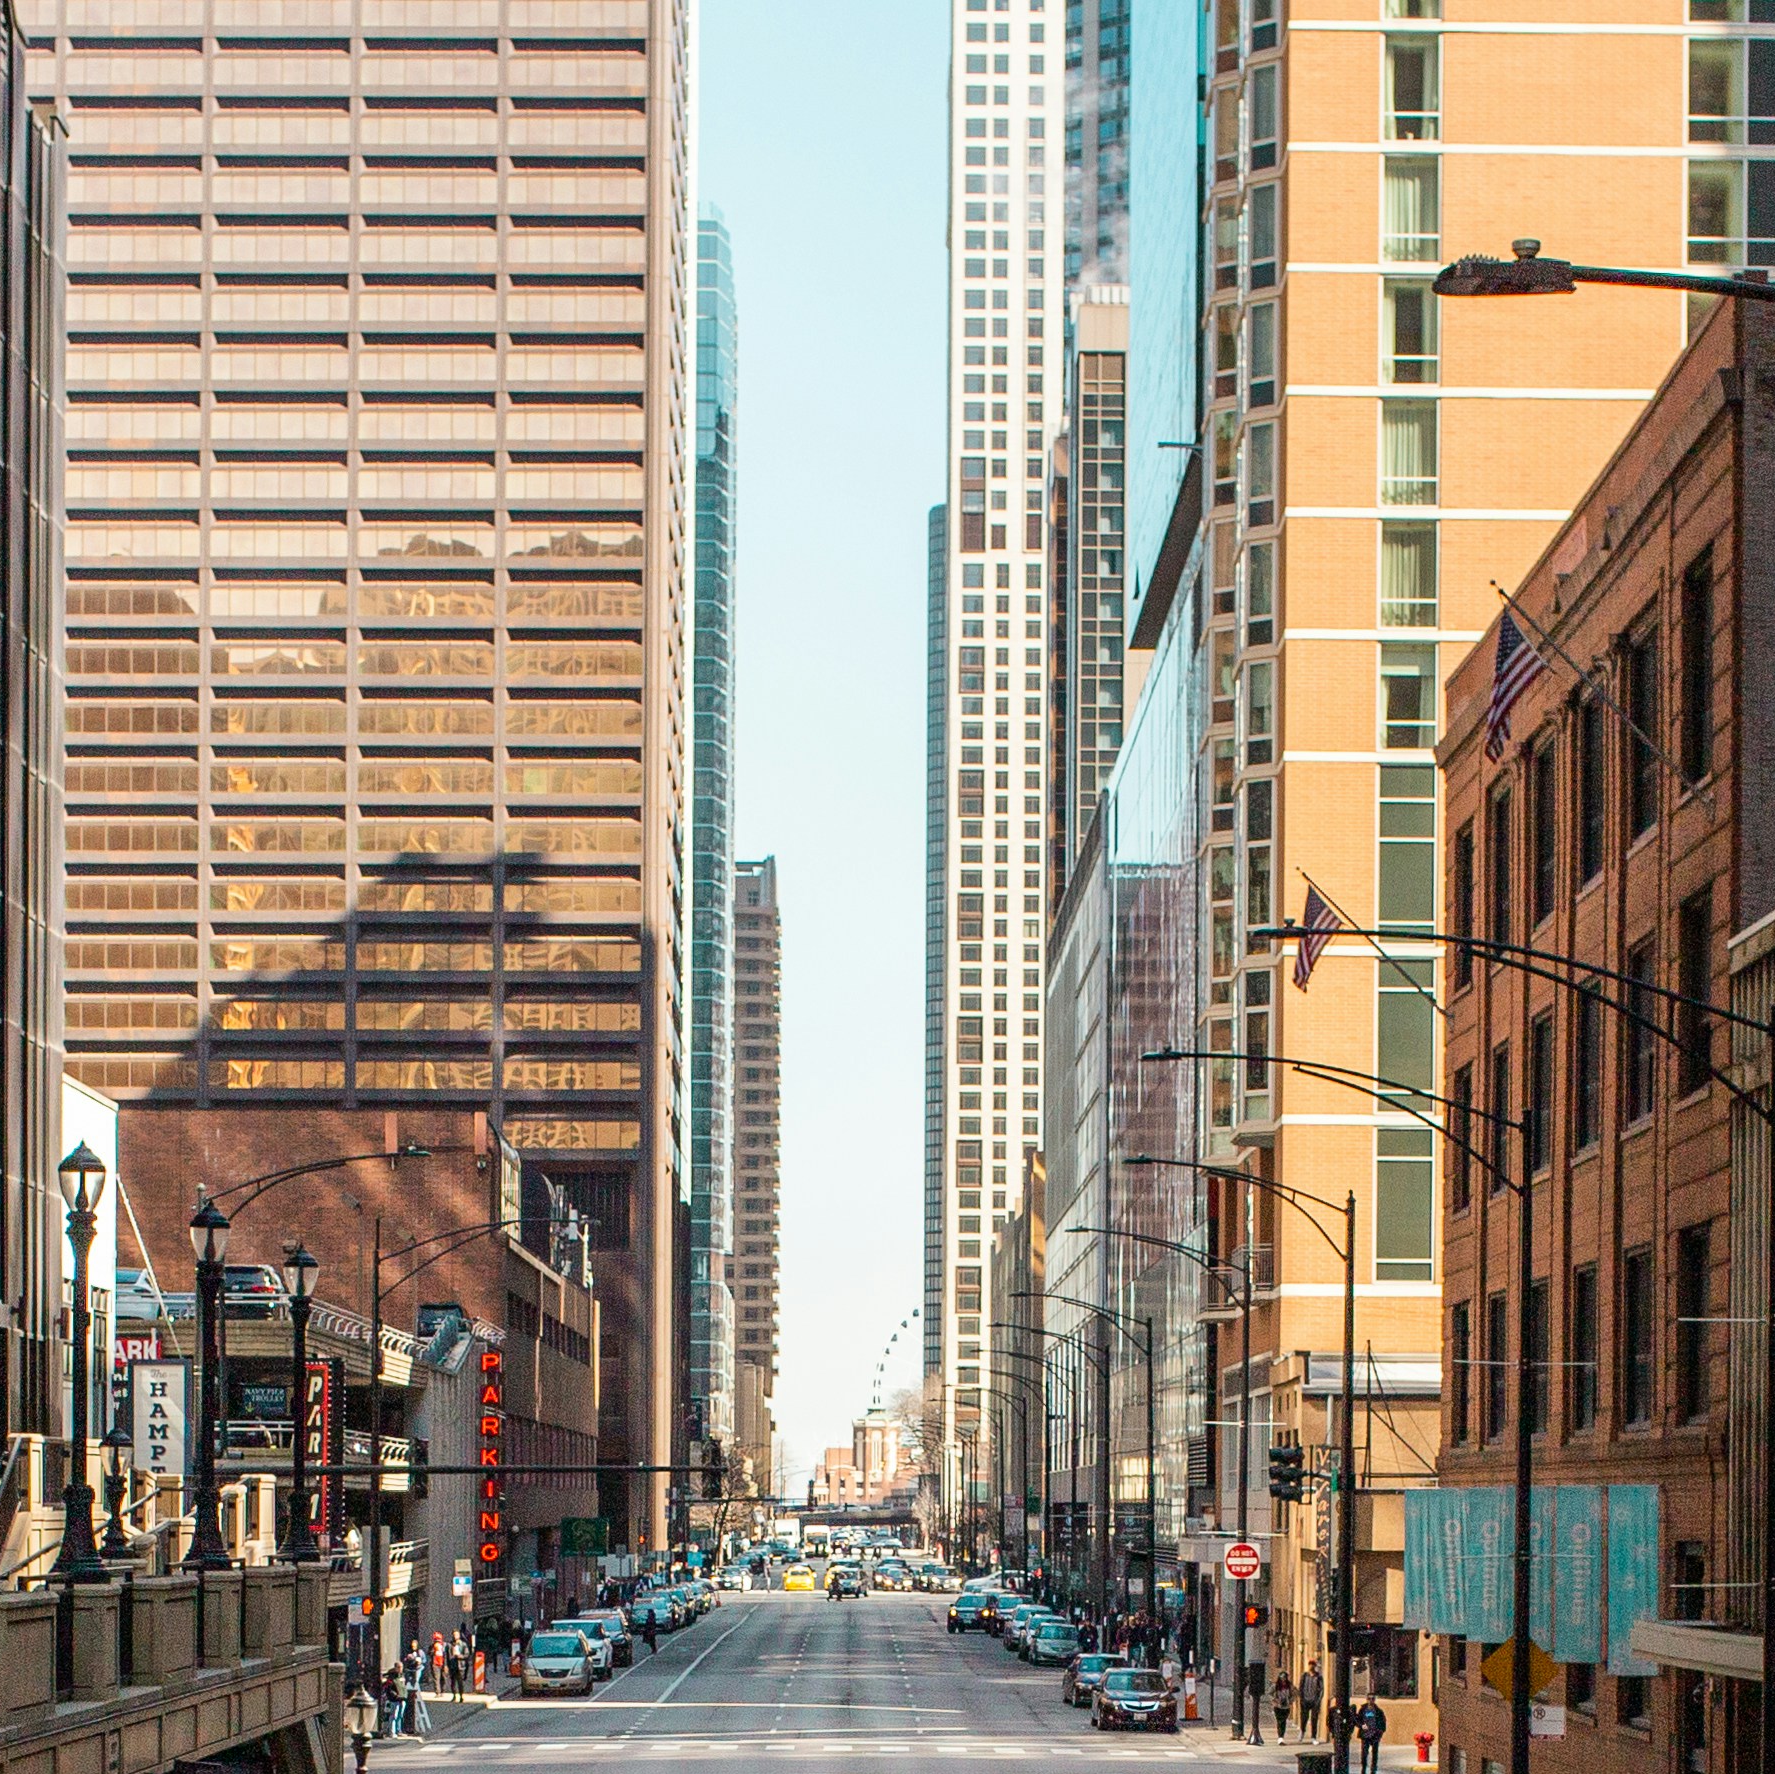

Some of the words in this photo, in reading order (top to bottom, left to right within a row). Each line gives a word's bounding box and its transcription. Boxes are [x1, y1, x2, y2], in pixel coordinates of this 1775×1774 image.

[115, 1339, 157, 1361] ARK
[150, 1368, 168, 1378] The
[481, 1353, 500, 1562] PARKING
